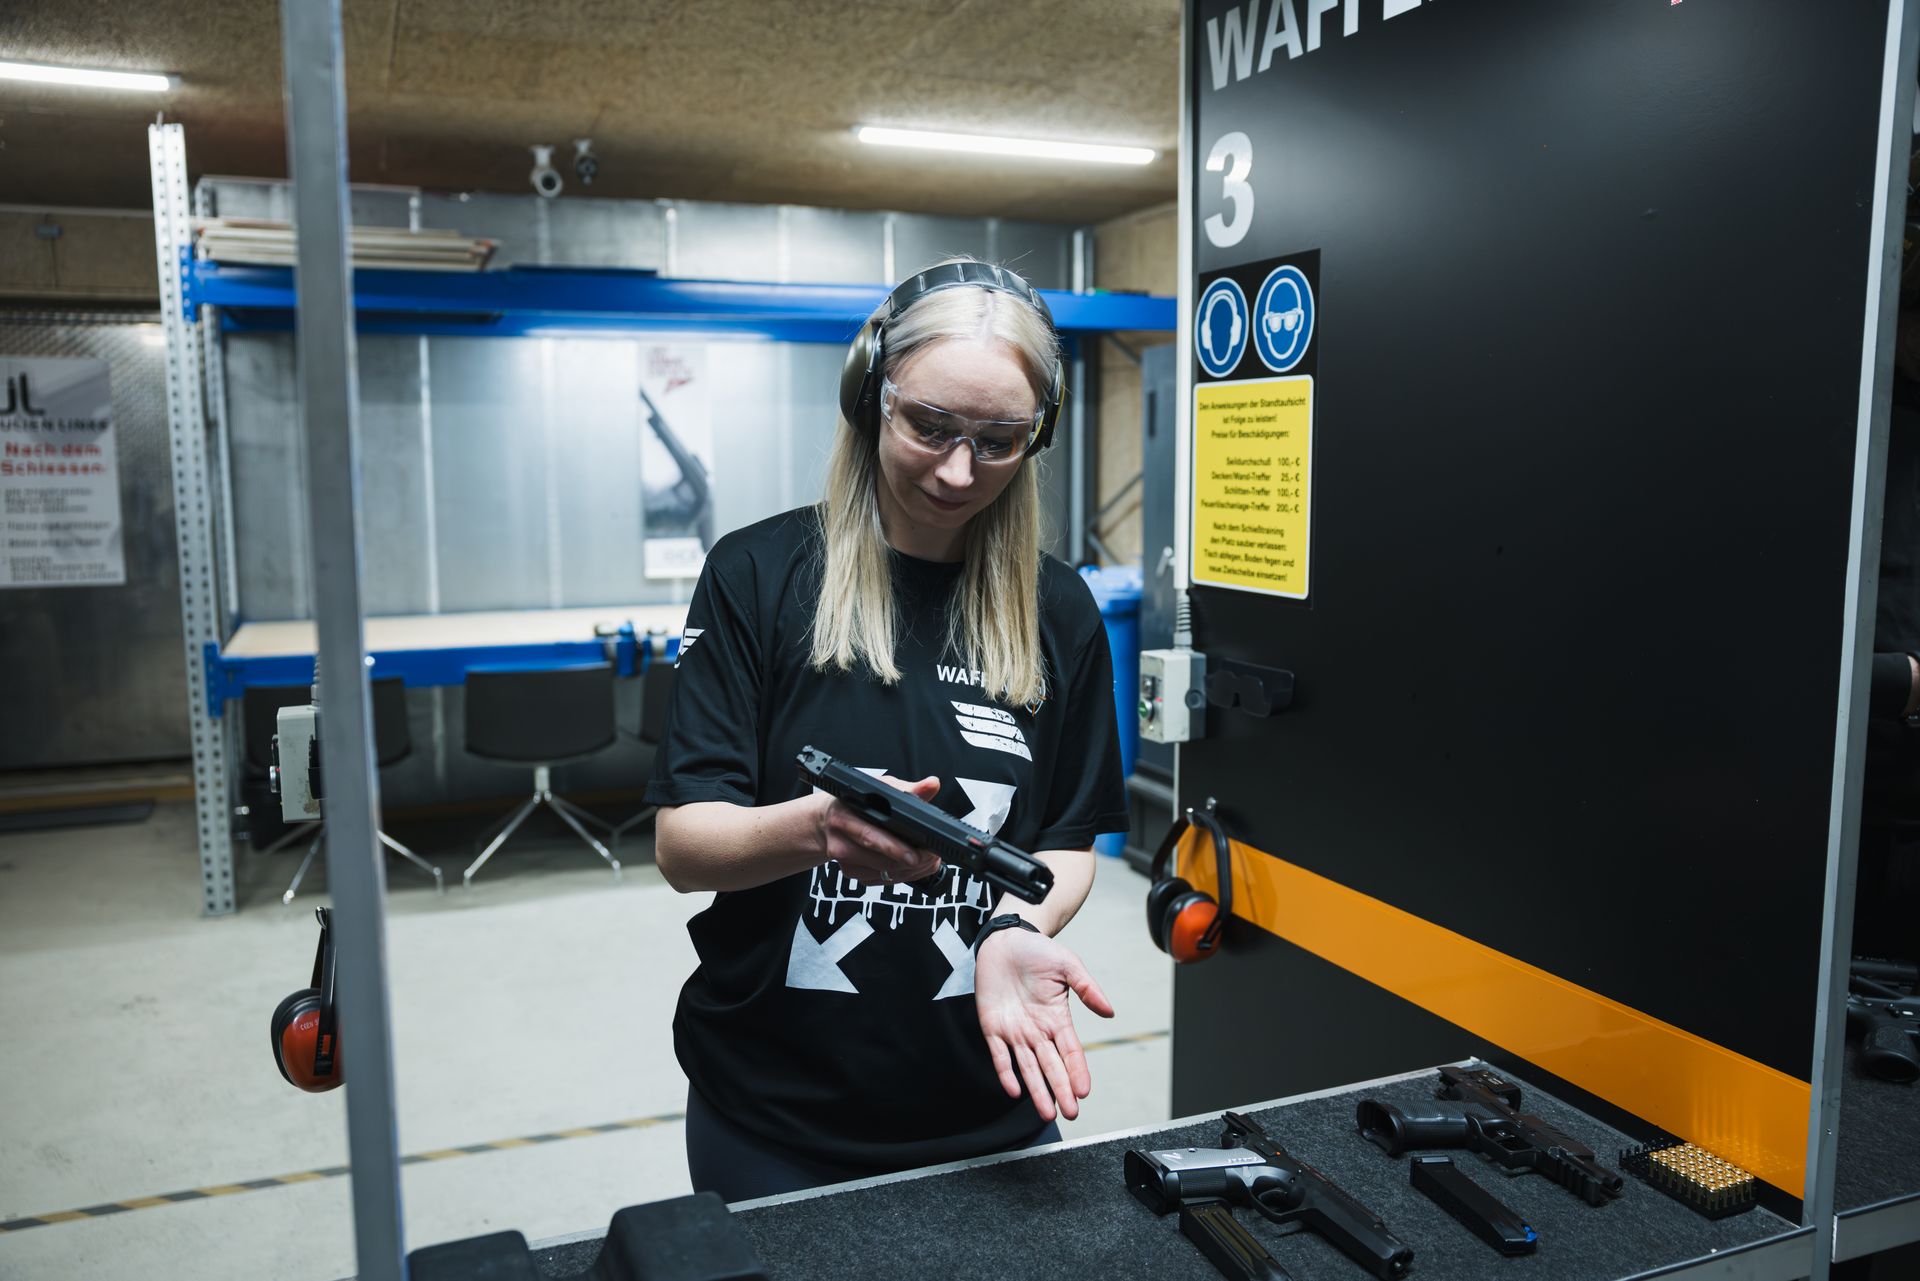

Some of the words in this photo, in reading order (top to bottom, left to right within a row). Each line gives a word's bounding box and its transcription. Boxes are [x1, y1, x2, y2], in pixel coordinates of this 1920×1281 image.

[1204, 131, 1255, 248] 3
[1210, 401, 1248, 410] Anweisungen
[1249, 400, 1258, 408] der
[1231, 415, 1246, 424] Folge
[1247, 416, 1254, 424] zu
[1211, 430, 1228, 438] Preise
[1229, 430, 1237, 438] für
[5, 441, 56, 457] Nach
[62, 443, 102, 457] dem
[1213, 522, 1227, 530] Nach
[1228, 523, 1240, 531] dem
[1222, 536, 1235, 546] Platz
[1236, 538, 1255, 548] sauber
[1204, 548, 1218, 558] Tisch
[1244, 553, 1263, 563] Boden
[1264, 556, 1282, 567] fegen
[1282, 558, 1295, 568] und
[1209, 565, 1222, 573] neue
[812, 858, 868, 899] NO
